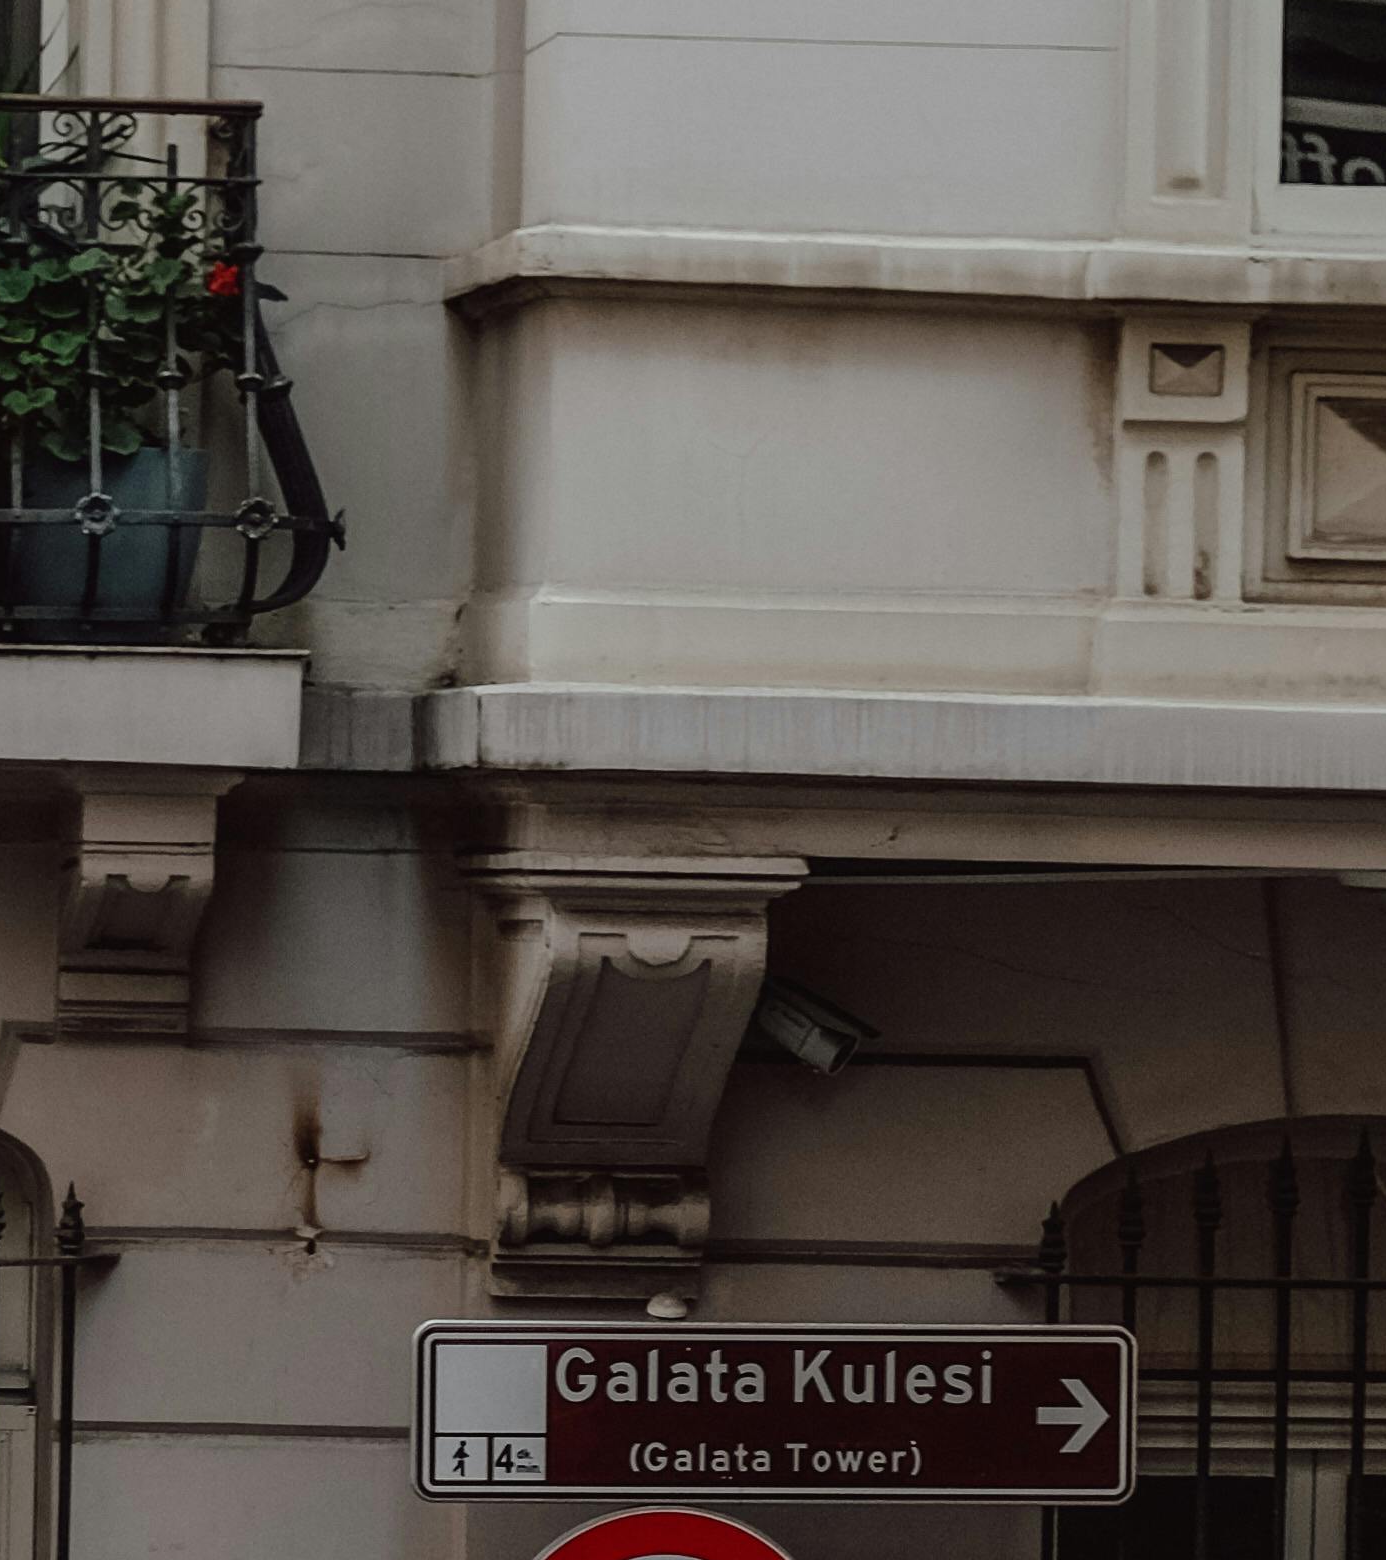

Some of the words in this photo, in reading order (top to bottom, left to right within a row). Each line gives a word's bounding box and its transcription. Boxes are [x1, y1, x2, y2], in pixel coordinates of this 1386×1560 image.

[556, 1348, 765, 1402] Galata
[794, 1350, 992, 1404] Kulesi
[495, 1443, 514, 1474] 4
[629, 1441, 771, 1474] (Galata
[786, 1441, 923, 1476] Tower)
